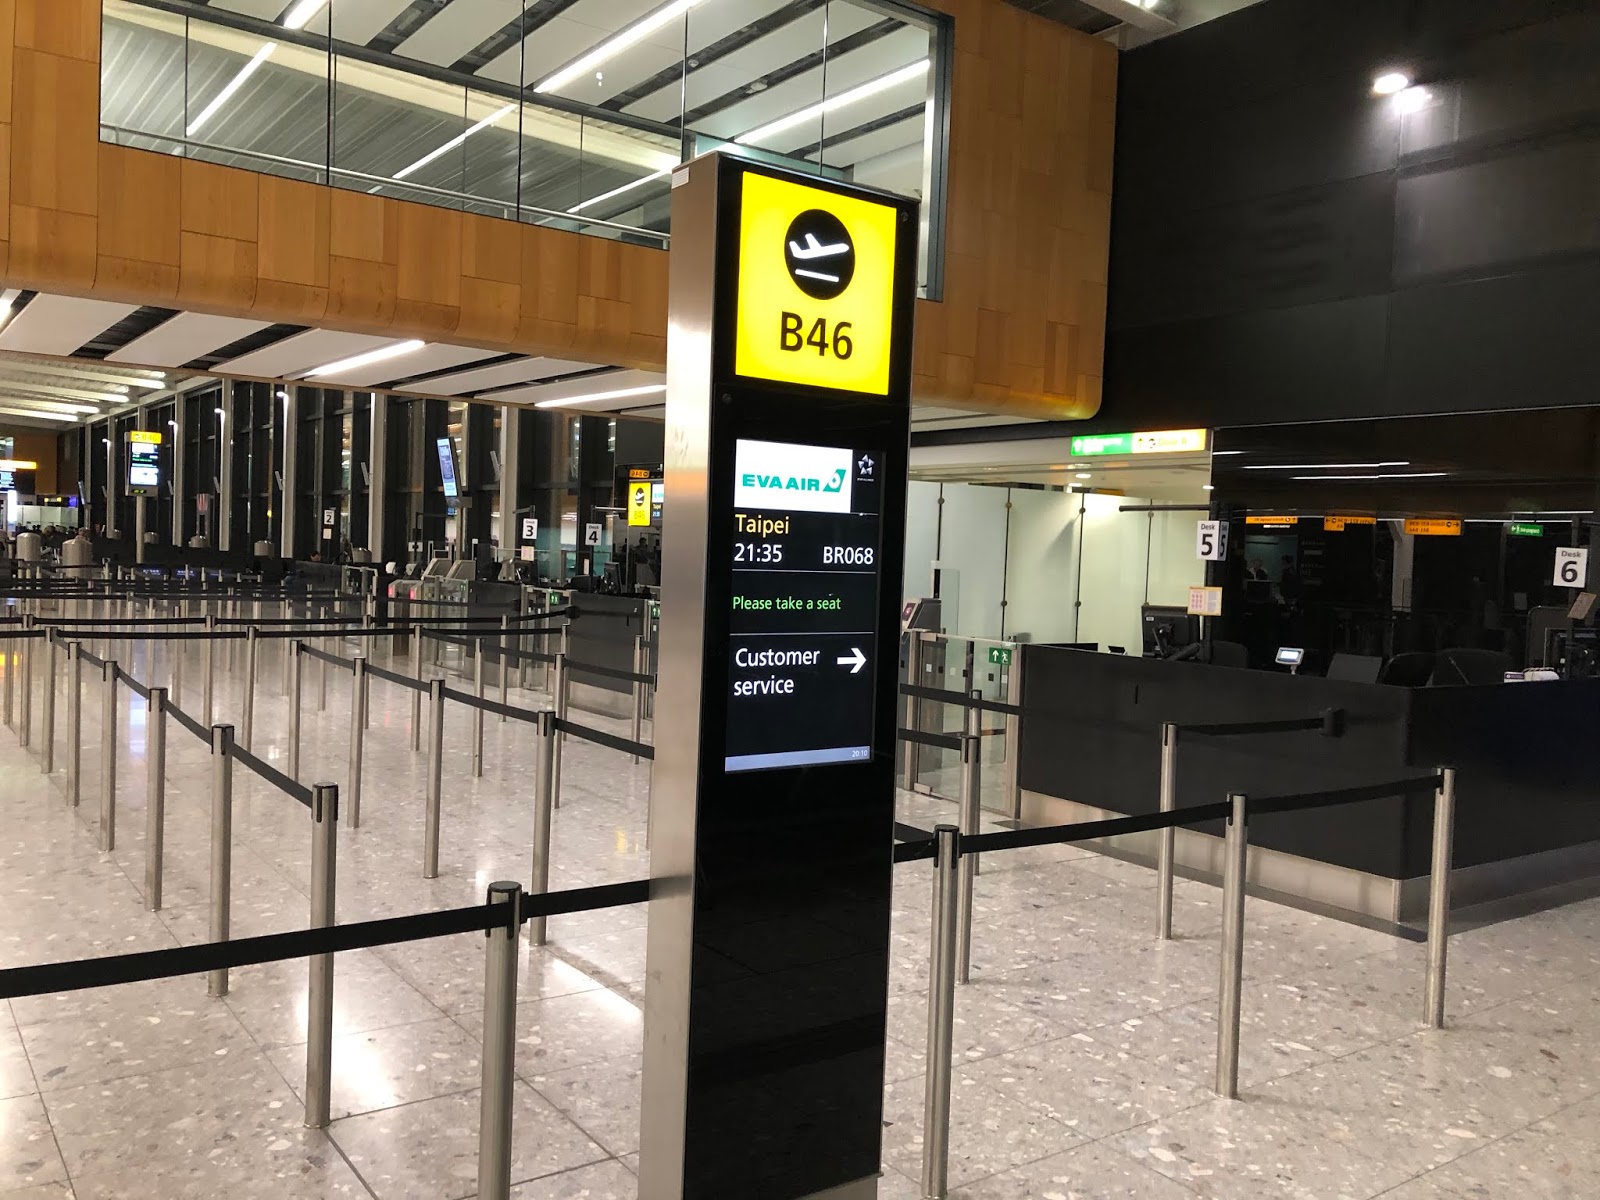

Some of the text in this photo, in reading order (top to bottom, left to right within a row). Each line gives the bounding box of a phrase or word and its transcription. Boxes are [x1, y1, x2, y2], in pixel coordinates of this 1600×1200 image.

[780, 311, 853, 361] B46
[742, 473, 820, 492] EVA AIR
[326, 514, 332, 523] 2
[735, 514, 790, 538] Taipei
[525, 525, 534, 537] 3
[588, 531, 598, 543] 4
[733, 542, 783, 563] 21:35
[1201, 533, 1213, 556] 5
[1561, 550, 1582, 558] Desk
[822, 546, 874, 565] BR068
[1561, 560, 1578, 583] 6
[732, 596, 842, 610] Please take a seat
[735, 648, 820, 667] Customer
[733, 675, 795, 696] service
